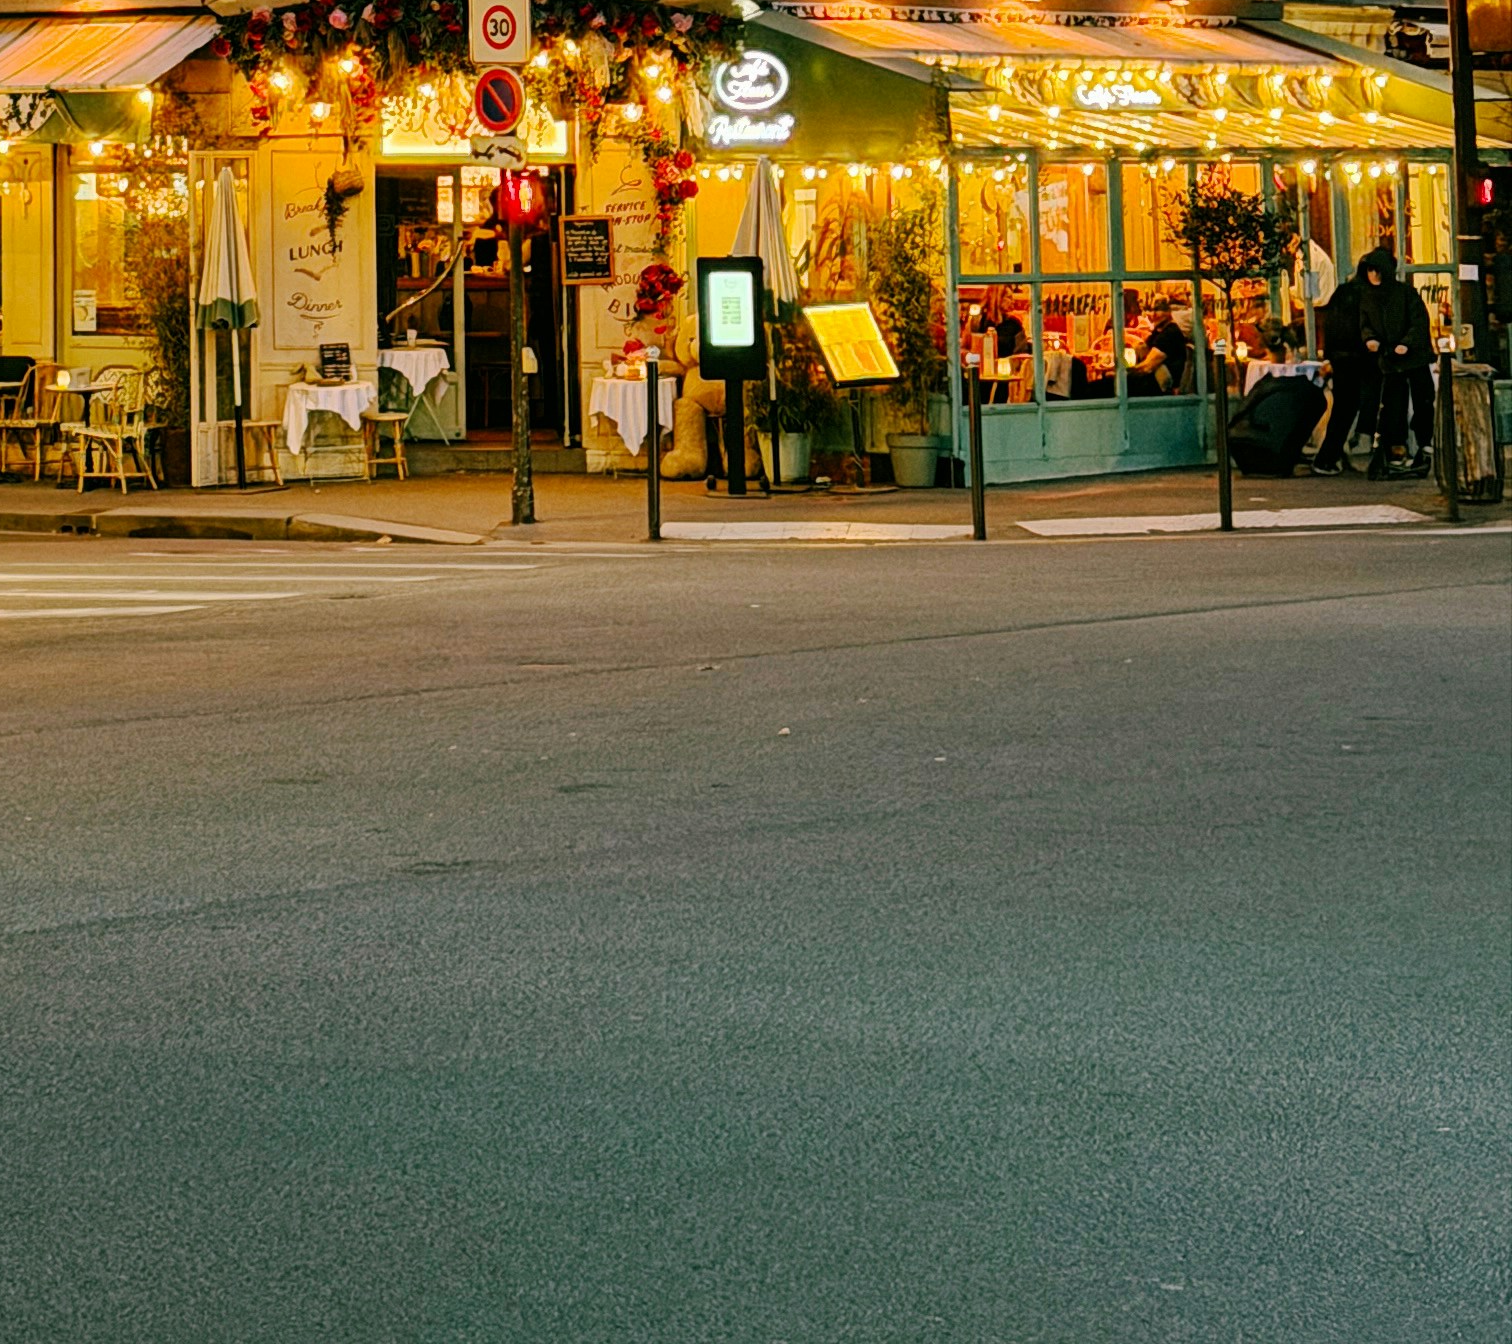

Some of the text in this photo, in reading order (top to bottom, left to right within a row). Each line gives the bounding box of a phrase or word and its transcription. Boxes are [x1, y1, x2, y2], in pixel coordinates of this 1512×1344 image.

[489, 18, 510, 37] 30
[605, 201, 647, 213] SERVICE
[289, 240, 343, 261] LUNCH
[287, 291, 343, 313] Dinner
